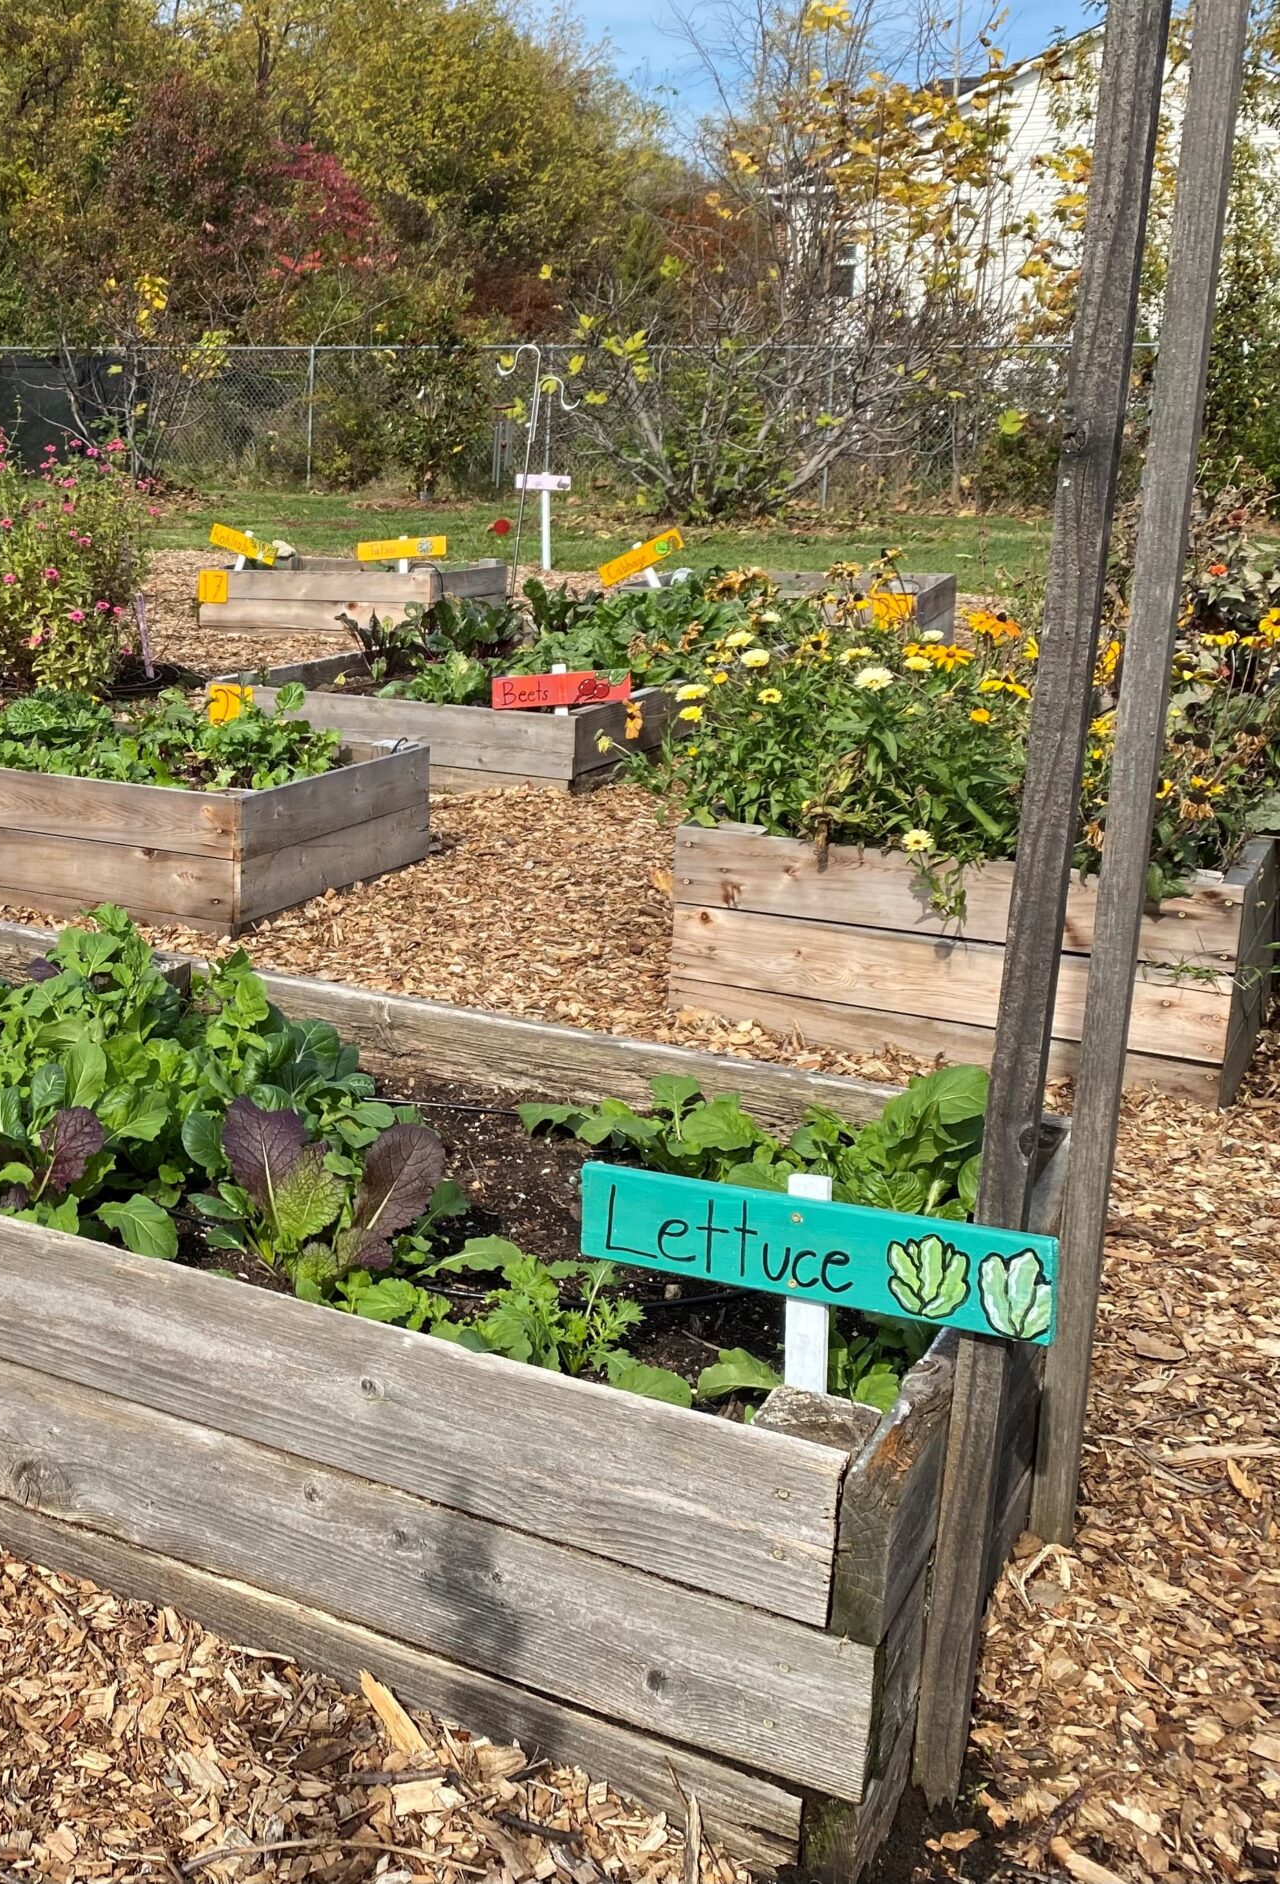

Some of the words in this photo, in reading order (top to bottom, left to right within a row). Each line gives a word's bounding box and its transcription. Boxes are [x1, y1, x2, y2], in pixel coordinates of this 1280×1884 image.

[202, 574, 224, 601] 17
[501, 680, 548, 706] Beets
[605, 1184, 853, 1292] Lettuce
